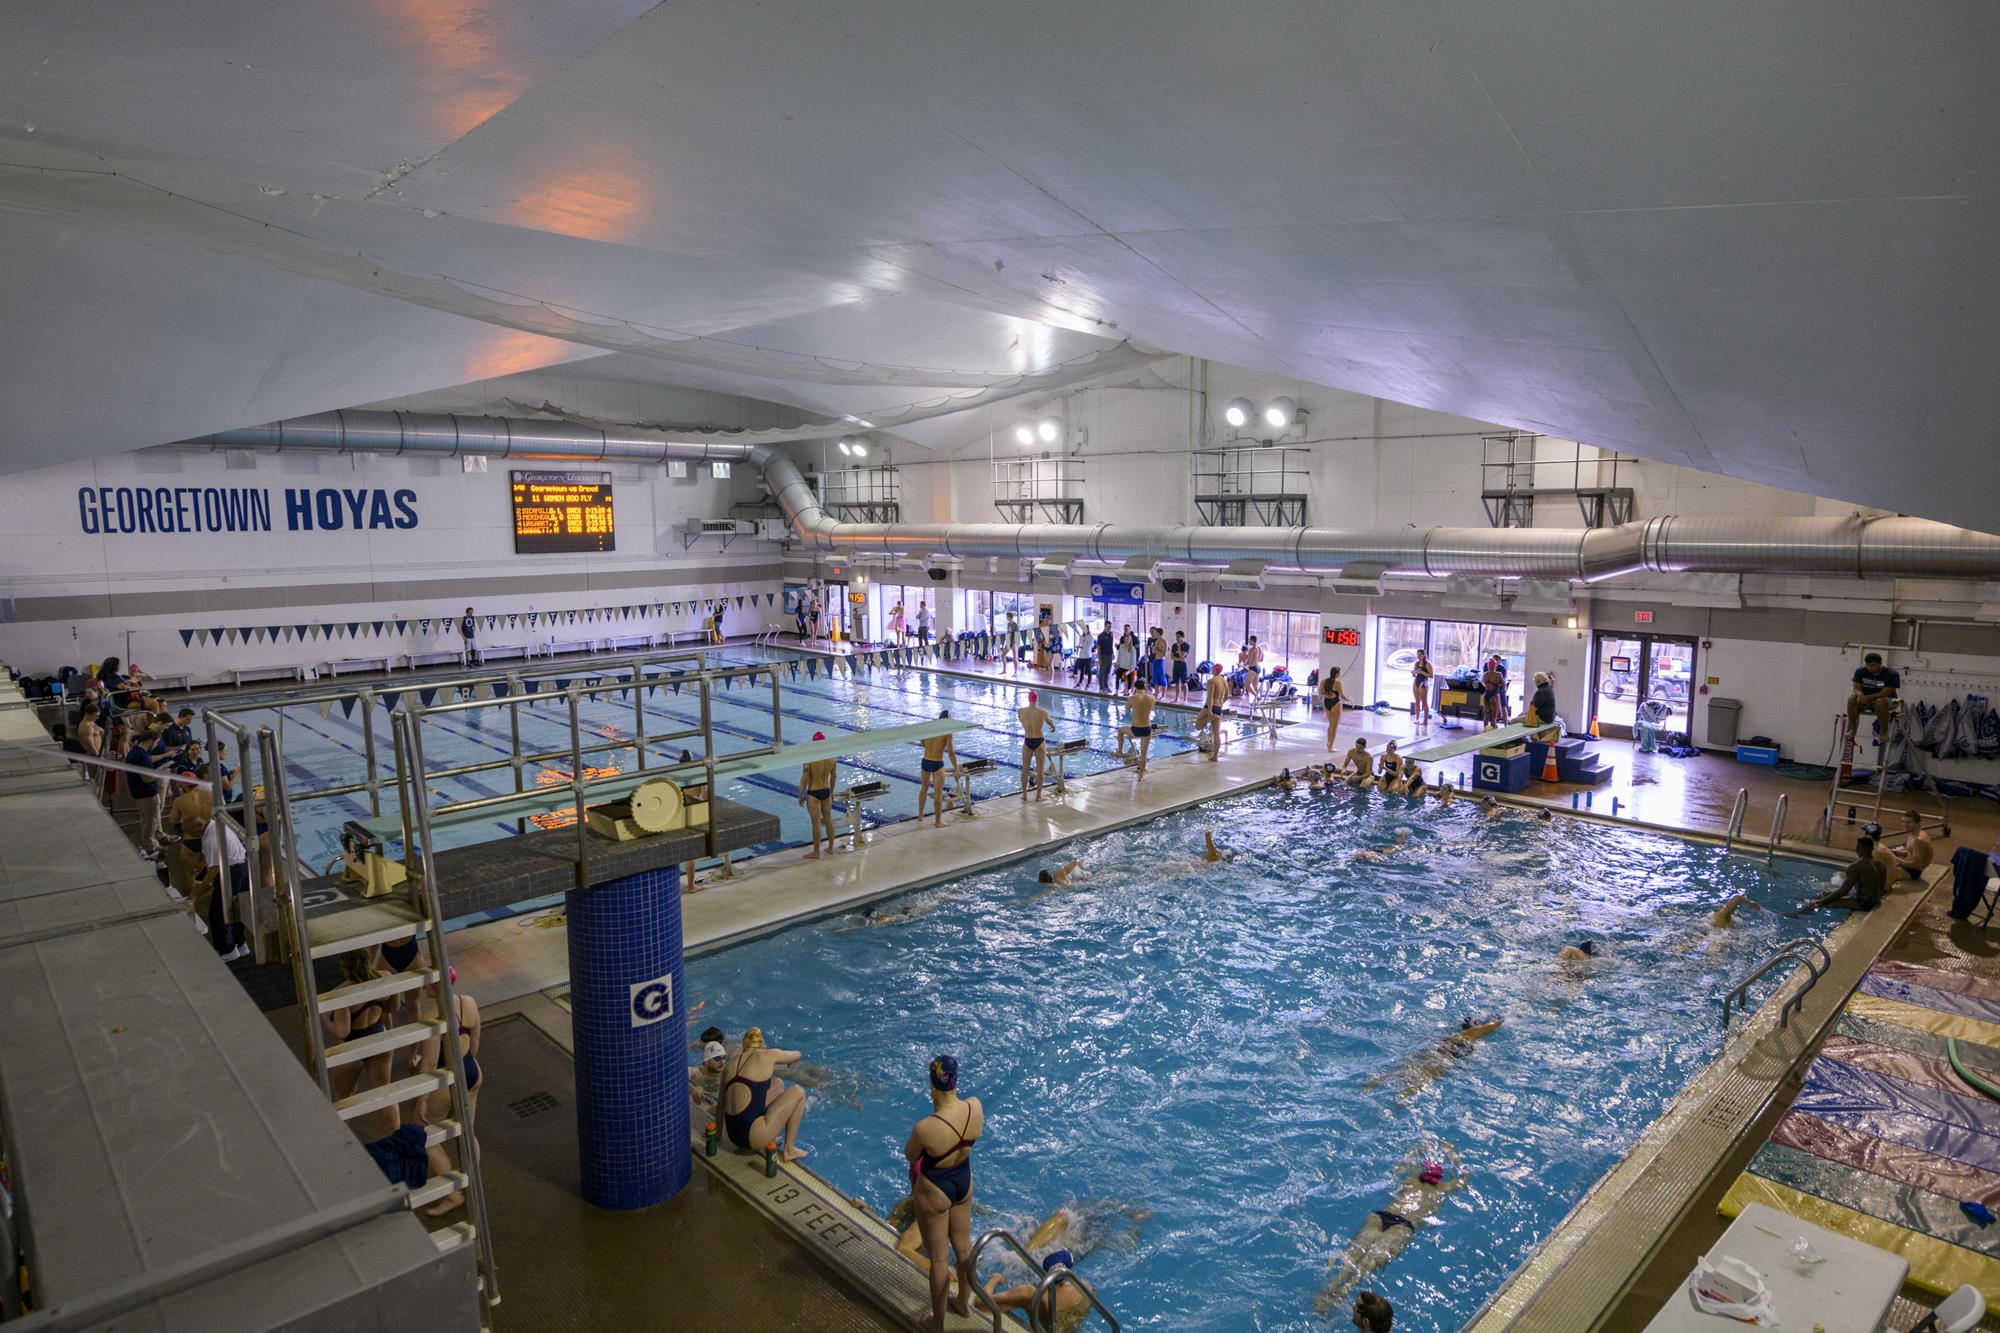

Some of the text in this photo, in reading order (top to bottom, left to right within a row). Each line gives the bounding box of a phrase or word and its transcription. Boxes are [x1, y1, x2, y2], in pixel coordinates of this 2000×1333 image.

[78, 487, 419, 534] GEORGETOWN HOYAS
[1636, 611, 1651, 622] EXIT
[1327, 630, 1357, 646] 41:58
[1482, 764, 1499, 780] G
[633, 981, 671, 1020] G
[766, 1183, 861, 1249] 13 FEET
